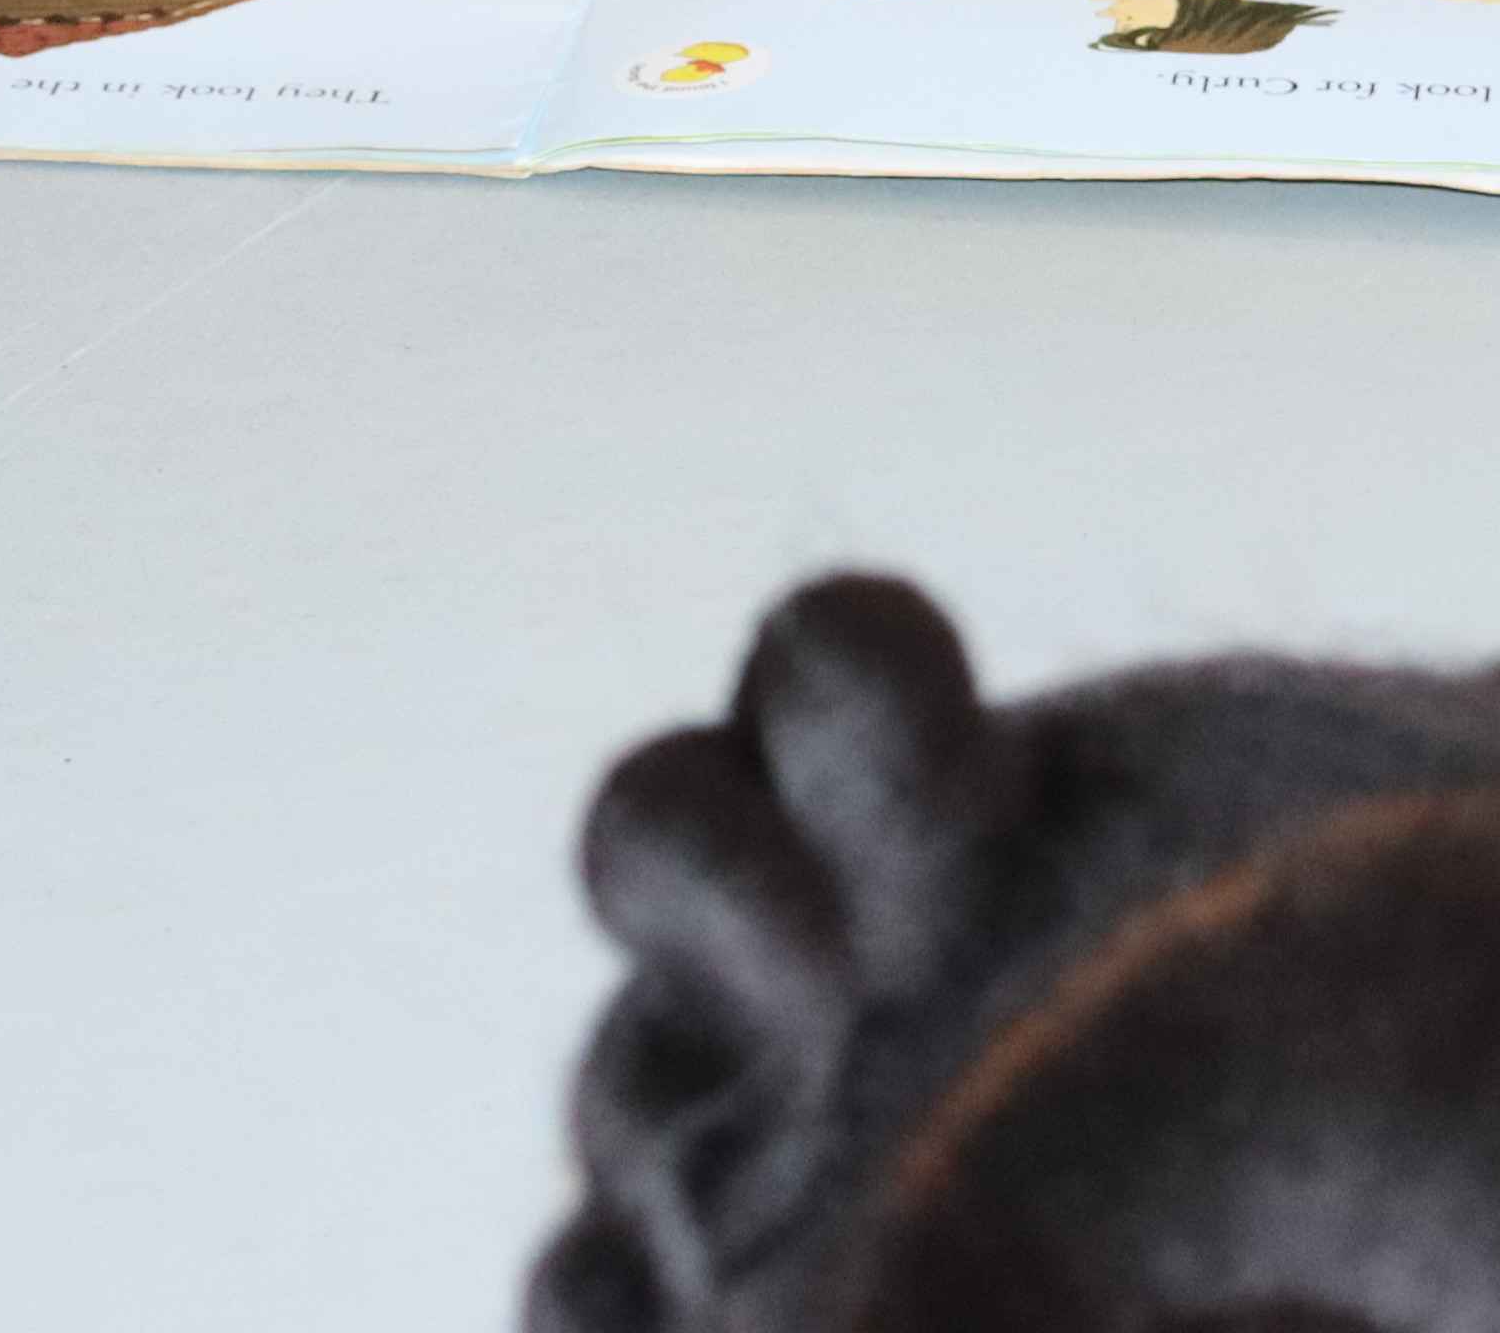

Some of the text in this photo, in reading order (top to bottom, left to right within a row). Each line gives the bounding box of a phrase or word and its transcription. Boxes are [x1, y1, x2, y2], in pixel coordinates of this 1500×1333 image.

[10, 77, 82, 98] the
[102, 80, 143, 94] in
[162, 83, 255, 103] look
[1157, 69, 1299, 96] Curly.
[1316, 80, 1381, 101] for
[1398, 82, 1491, 102] look
[277, 84, 391, 107] They
